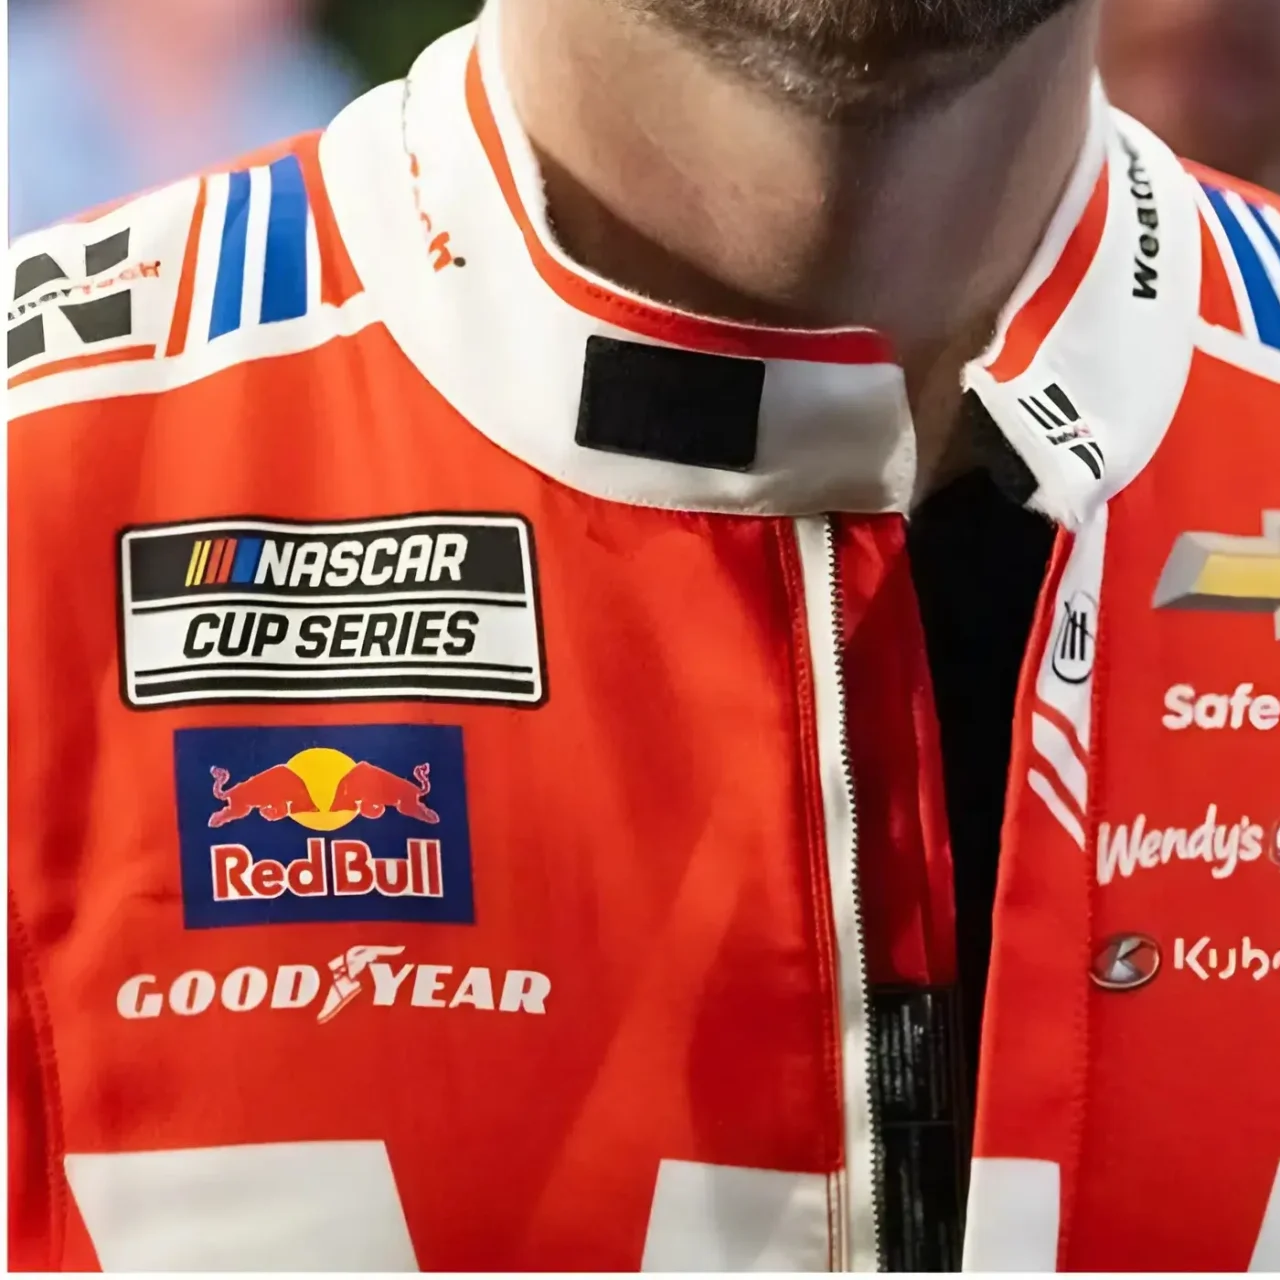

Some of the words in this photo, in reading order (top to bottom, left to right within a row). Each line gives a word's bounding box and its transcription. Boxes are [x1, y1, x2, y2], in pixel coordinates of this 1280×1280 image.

[253, 532, 469, 588] NASCAR
[182, 611, 289, 659] CUP
[294, 609, 480, 659] SERIES
[209, 837, 328, 902] Red
[332, 837, 444, 898] Bull
[1097, 803, 1264, 886] Wendy's
[116, 956, 552, 1022] GOODYEAR
